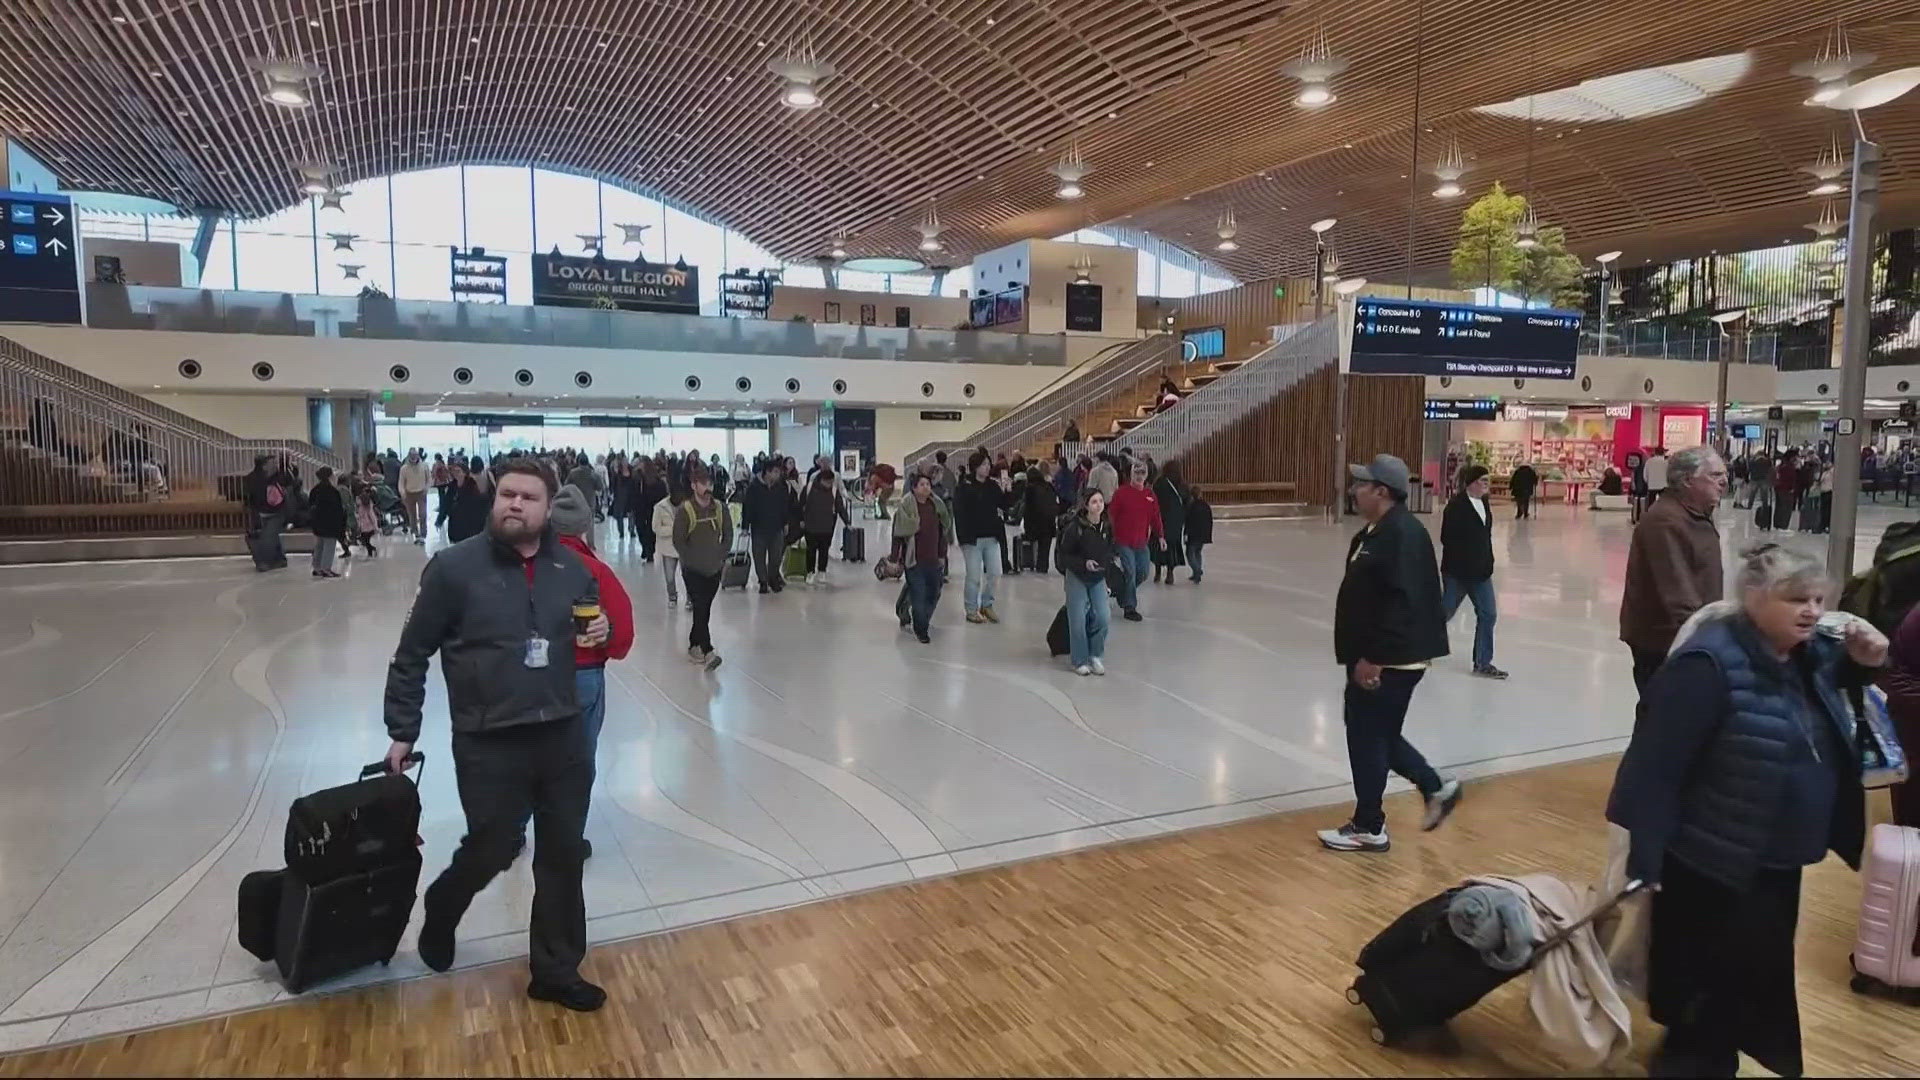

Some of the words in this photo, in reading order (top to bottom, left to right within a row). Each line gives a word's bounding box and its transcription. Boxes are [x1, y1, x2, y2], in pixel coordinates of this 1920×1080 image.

[548, 262, 615, 281] LOYAL
[621, 268, 687, 286] LEGION
[568, 281, 609, 292] OREGON
[612, 285, 636, 295] BEER
[640, 287, 667, 297] HALL
[1400, 326, 1421, 335] Arrivals
[1474, 329, 1491, 338] Found
